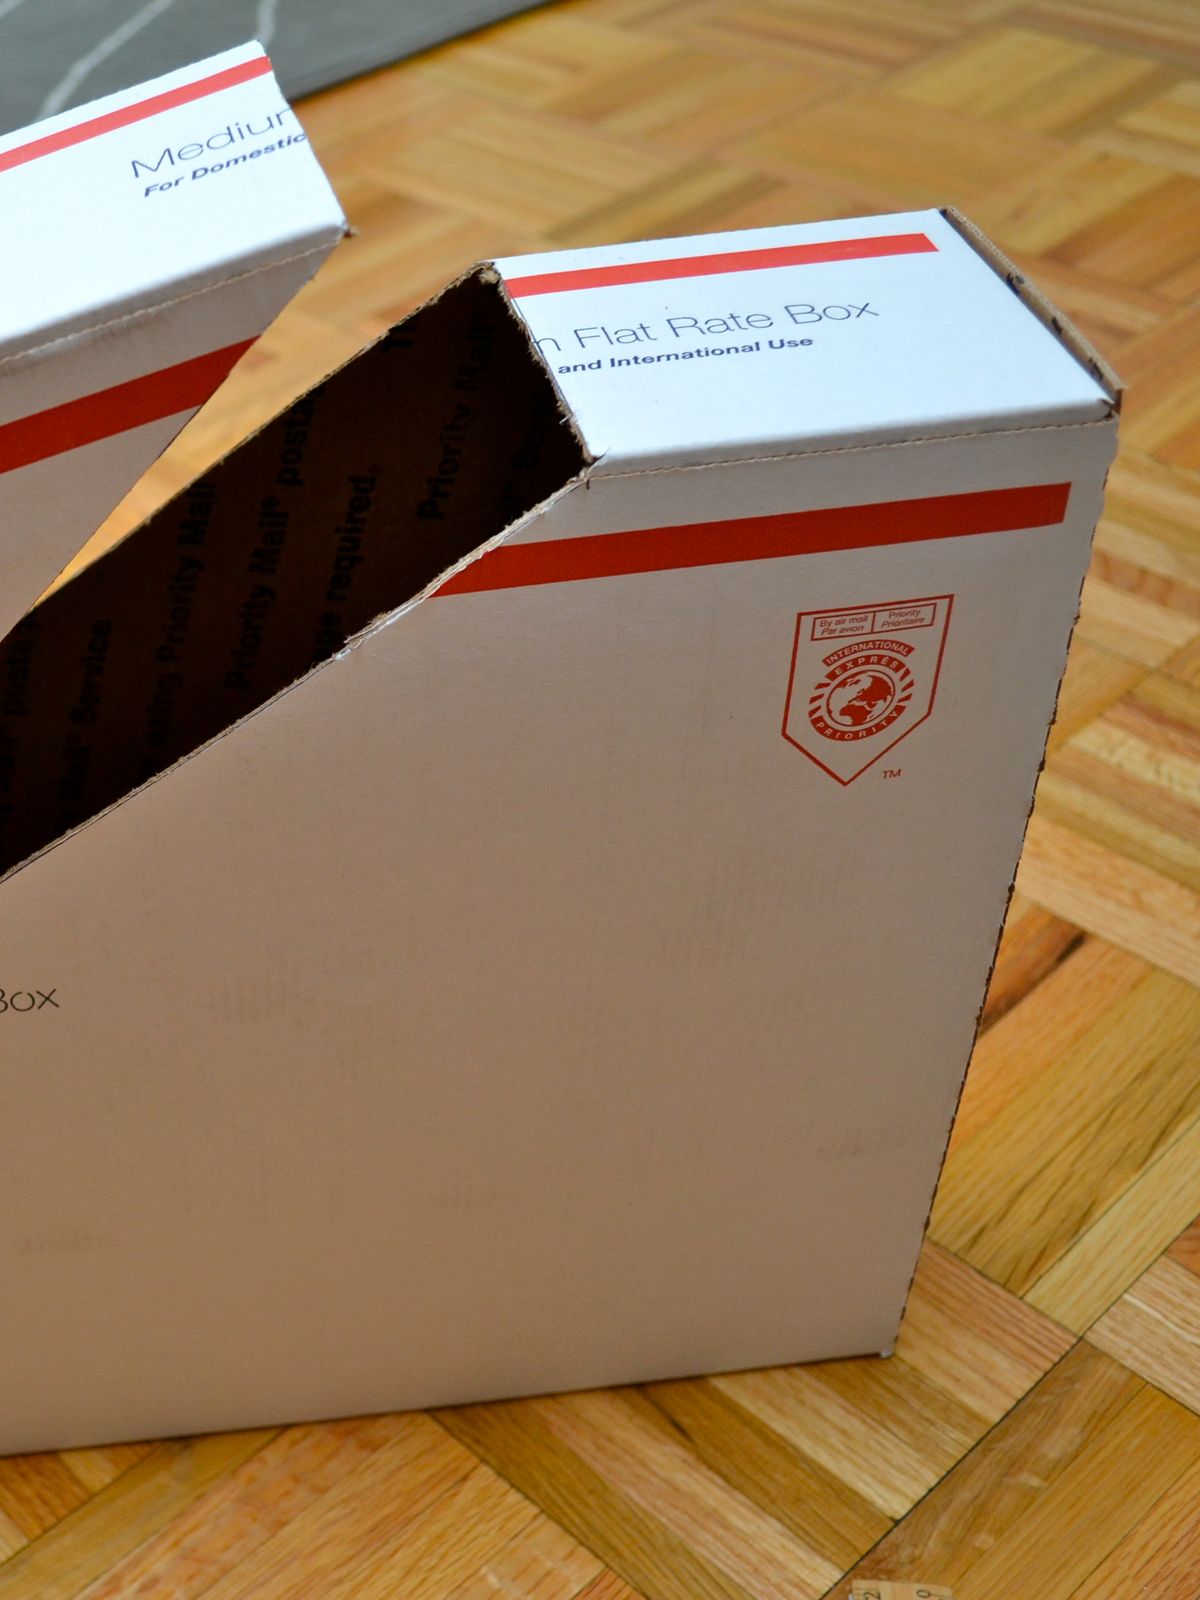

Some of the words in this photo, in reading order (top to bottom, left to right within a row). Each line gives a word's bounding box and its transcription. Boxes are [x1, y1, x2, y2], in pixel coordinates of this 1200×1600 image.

[143, 177, 184, 198] For
[574, 323, 658, 349] Flat
[666, 313, 774, 337] Rate
[784, 303, 879, 325] Box
[558, 360, 602, 374] and
[610, 342, 760, 368] International
[768, 338, 814, 350] Use
[820, 619, 832, 628] By
[834, 616, 847, 626] air
[849, 615, 868, 624] mail
[839, 625, 864, 634] avion
[825, 641, 908, 664] INTERNATIONAL
[816, 710, 898, 740] PRIORITY
